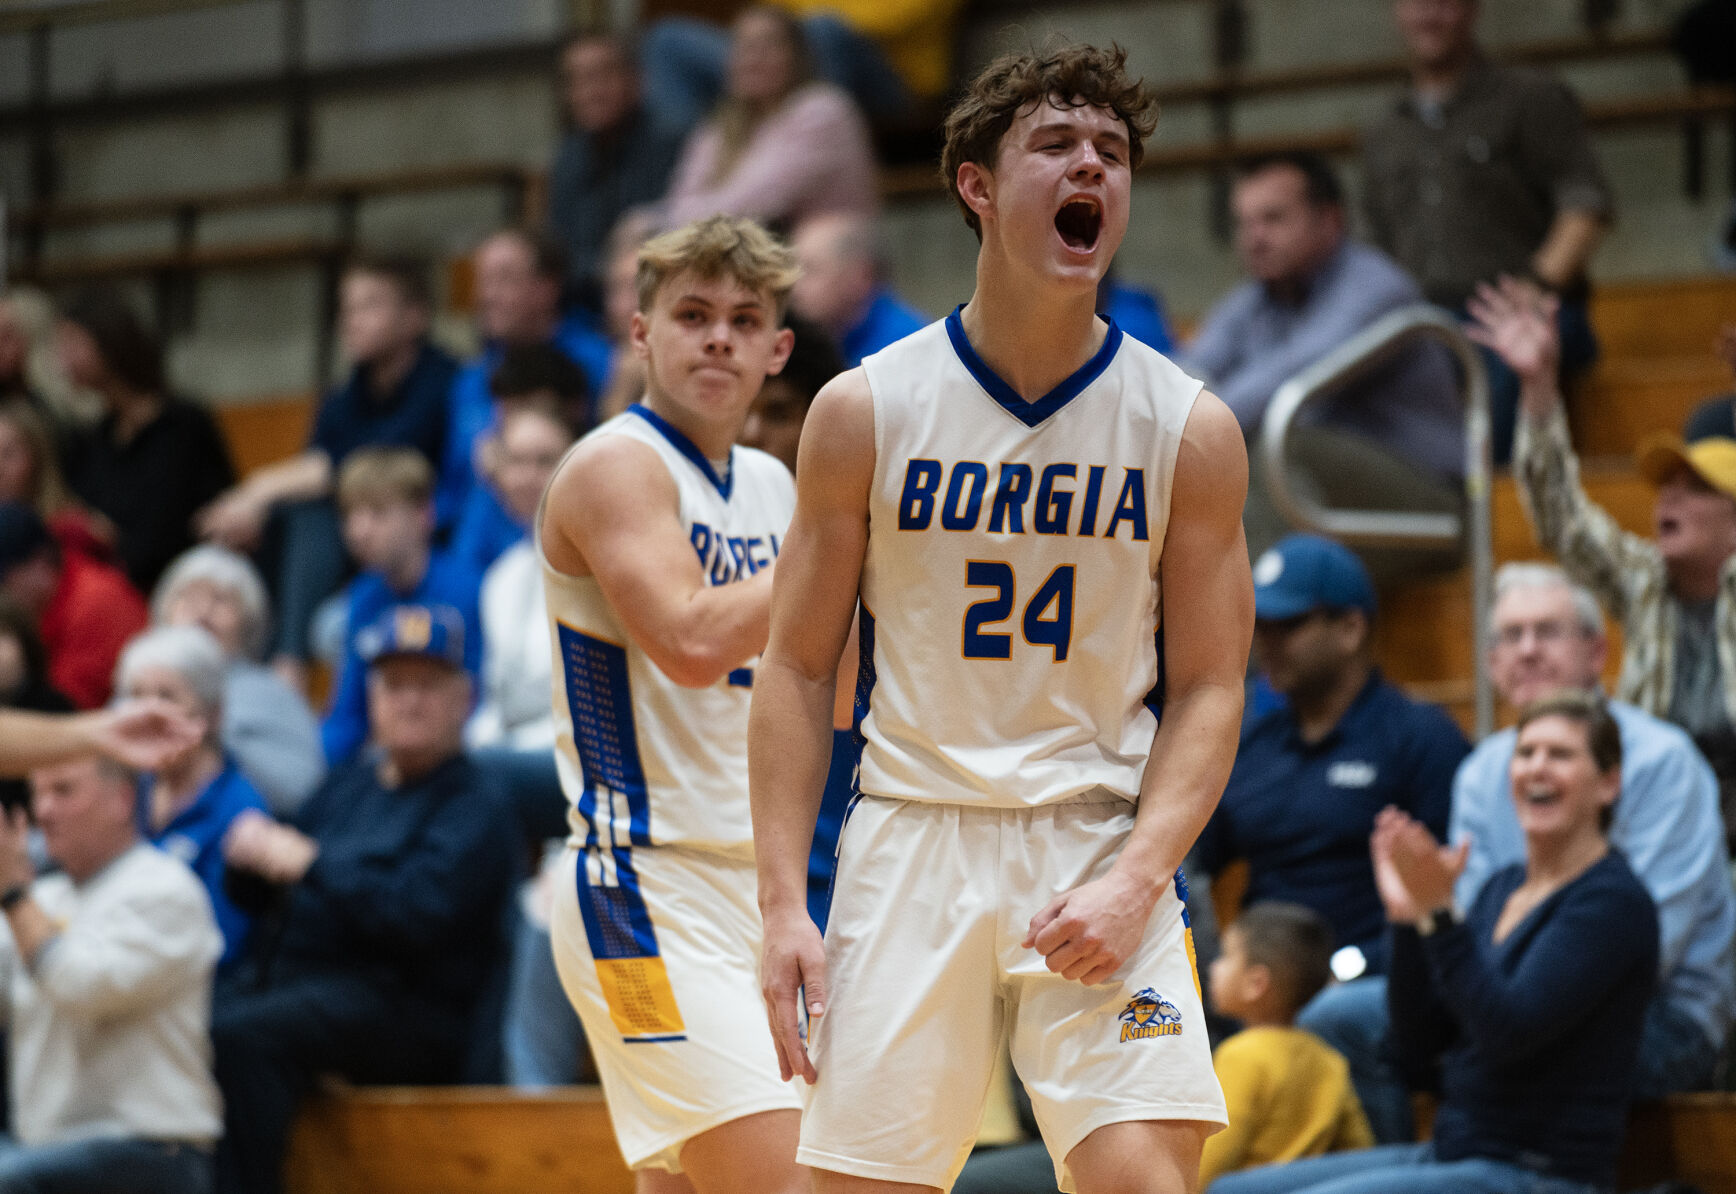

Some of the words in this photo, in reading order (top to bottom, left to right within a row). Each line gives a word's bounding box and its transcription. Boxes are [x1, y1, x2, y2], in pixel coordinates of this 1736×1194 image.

[897, 458, 1150, 542] BORGIA
[961, 558, 1077, 664] 24
[1120, 1022, 1183, 1043] Knights
